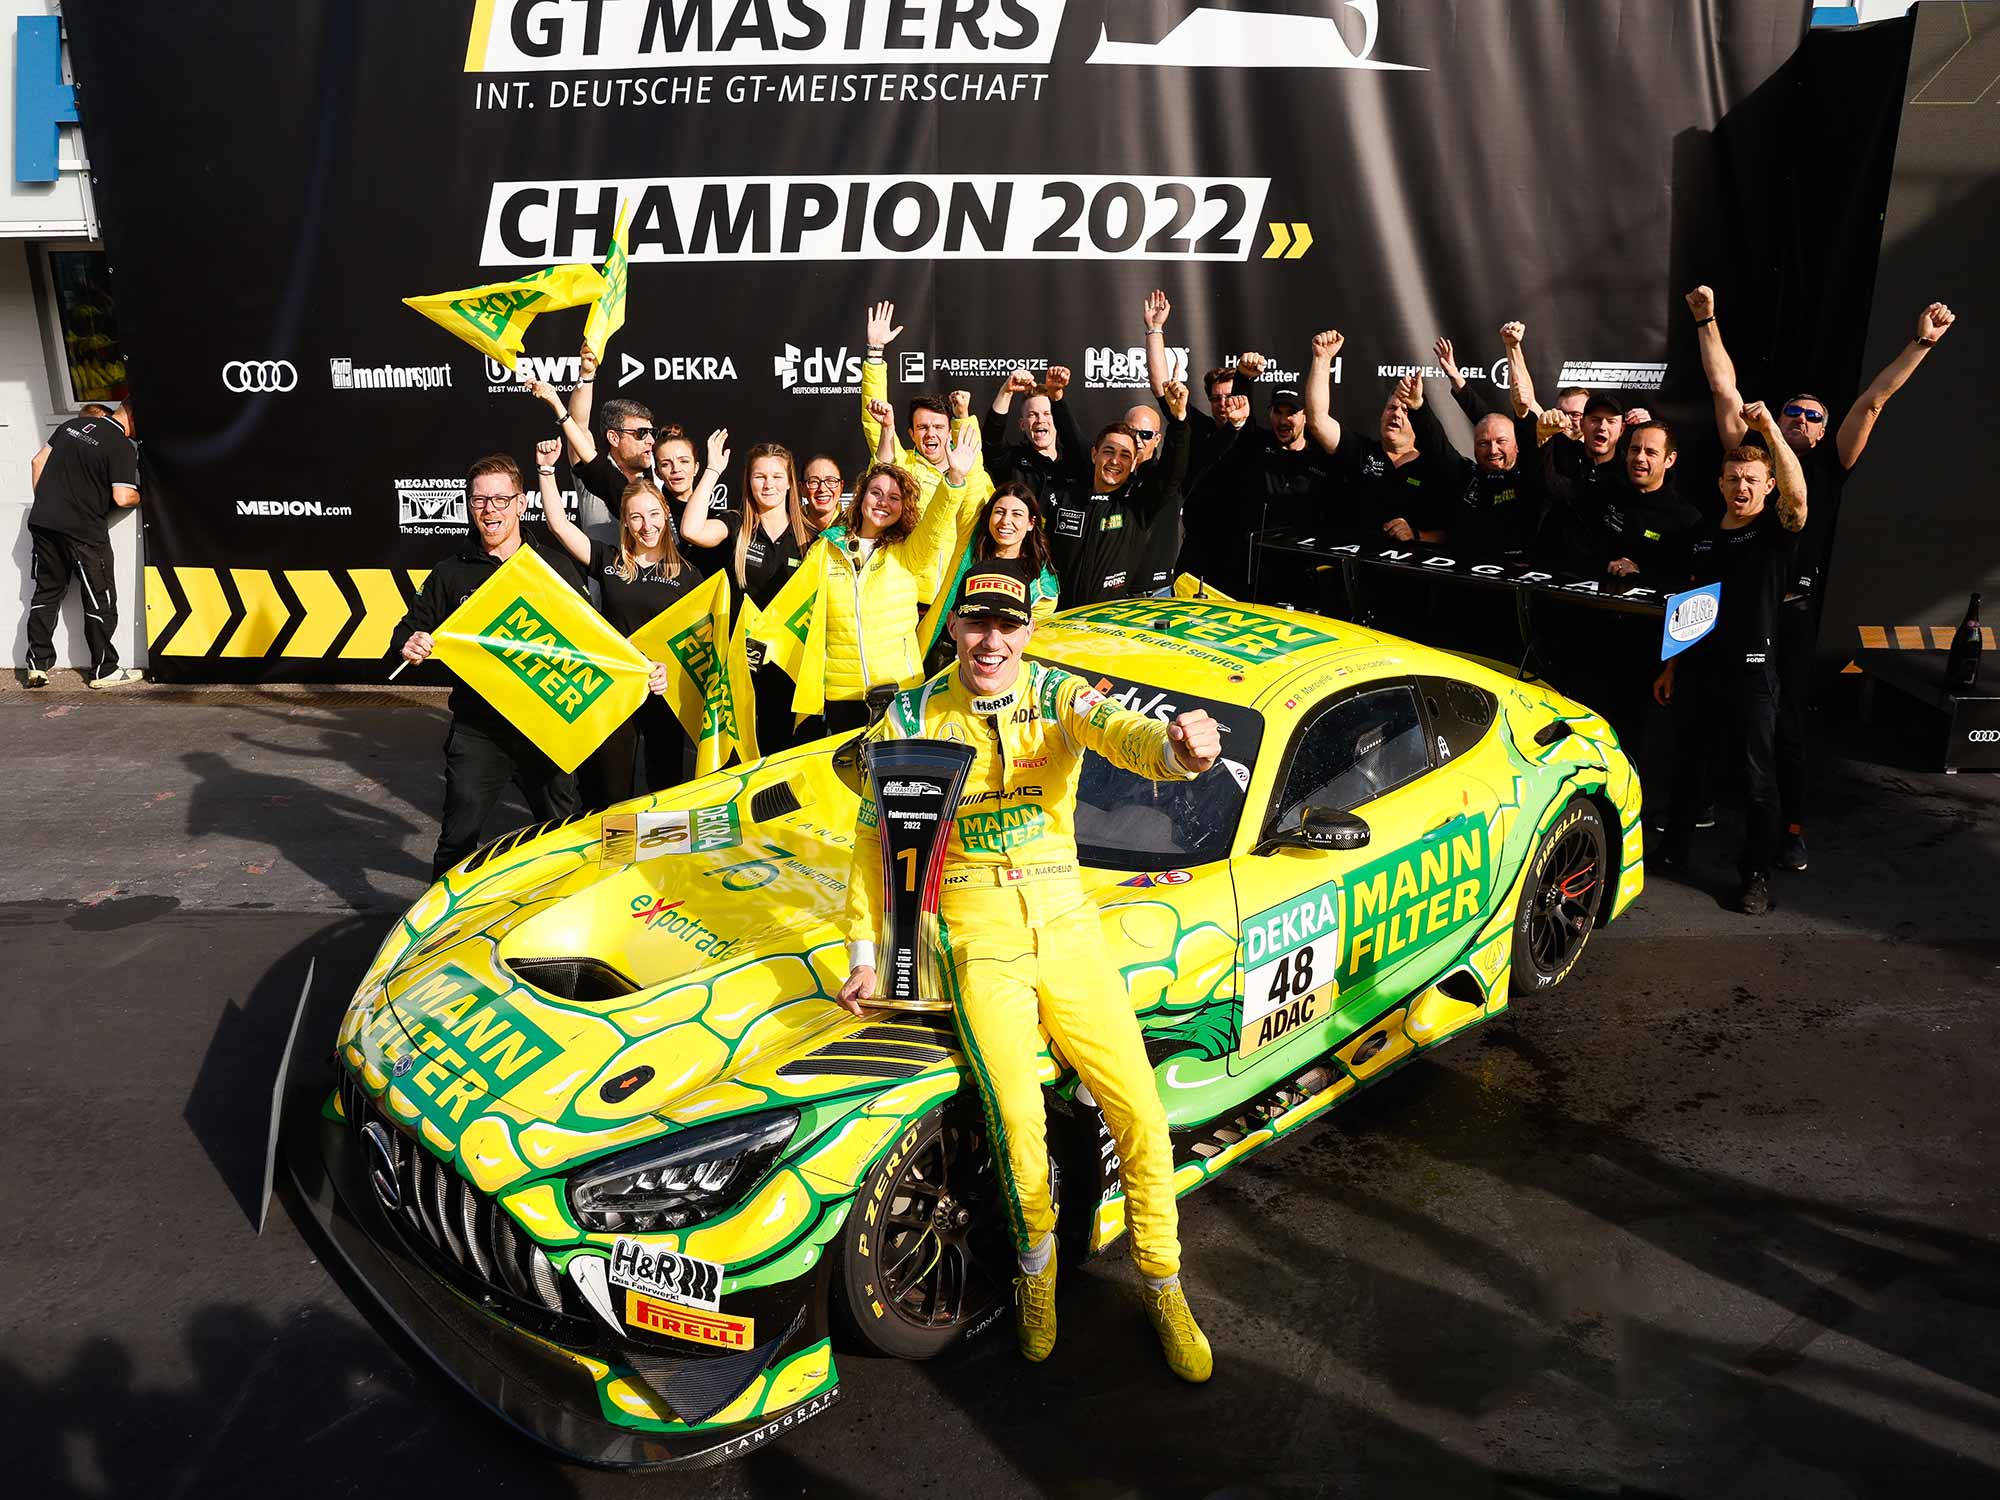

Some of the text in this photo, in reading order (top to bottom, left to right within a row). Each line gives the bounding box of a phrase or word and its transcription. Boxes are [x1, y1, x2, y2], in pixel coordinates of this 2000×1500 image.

[510, 0, 1040, 57] GT MASTERS
[475, 73, 1049, 110] INT. DEUTSCHE GT-MEISTERSCHAFT
[499, 180, 1246, 259] CHAMPION 2022
[515, 357, 582, 383] BWT
[654, 356, 738, 381] DEKRA
[932, 359, 1049, 371] FABEREXPOSIZE
[1559, 368, 1666, 382] MANNESMANN
[1621, 382, 1661, 390] WERKZEUGE
[792, 387, 819, 395] DEUTSCHER
[394, 479, 467, 489] MEGAFORCE
[237, 500, 352, 517] MEDION.com
[400, 526, 470, 537] The Stage Company
[968, 576, 1023, 597] PIRELLI
[1296, 537, 1656, 596] LANDGRAF
[1079, 606, 1279, 656] FILTER
[1117, 599, 1317, 643] MANN
[486, 624, 583, 715] FILTER
[505, 606, 605, 695] MANN
[1131, 633, 1188, 652] Perfect
[1186, 648, 1246, 674] service.
[1010, 705, 1040, 725] ADAC
[640, 825, 689, 849] 48
[697, 805, 733, 850] DEKRA
[887, 810, 938, 820] Fahrerwertung
[903, 821, 921, 829] 2022
[964, 806, 1038, 835] MANN
[965, 824, 1041, 850] FILTER
[1535, 808, 1583, 879] PIRELLI
[896, 847, 917, 892] 1
[1352, 827, 1481, 928] MANN
[1247, 893, 1336, 964] DEKRA
[1349, 878, 1481, 977] FILTER
[1267, 945, 1314, 1005] 48
[405, 973, 543, 1081] MANN
[1257, 993, 1316, 1048] ADAC
[360, 1003, 490, 1124] FILTER
[858, 1127, 918, 1257] P ZERO
[611, 1275, 680, 1301] Das Fahrwerk!
[613, 1240, 680, 1293] H&R
[636, 1299, 747, 1345] PIRELLI
[724, 1392, 832, 1456] LANDGRAF
